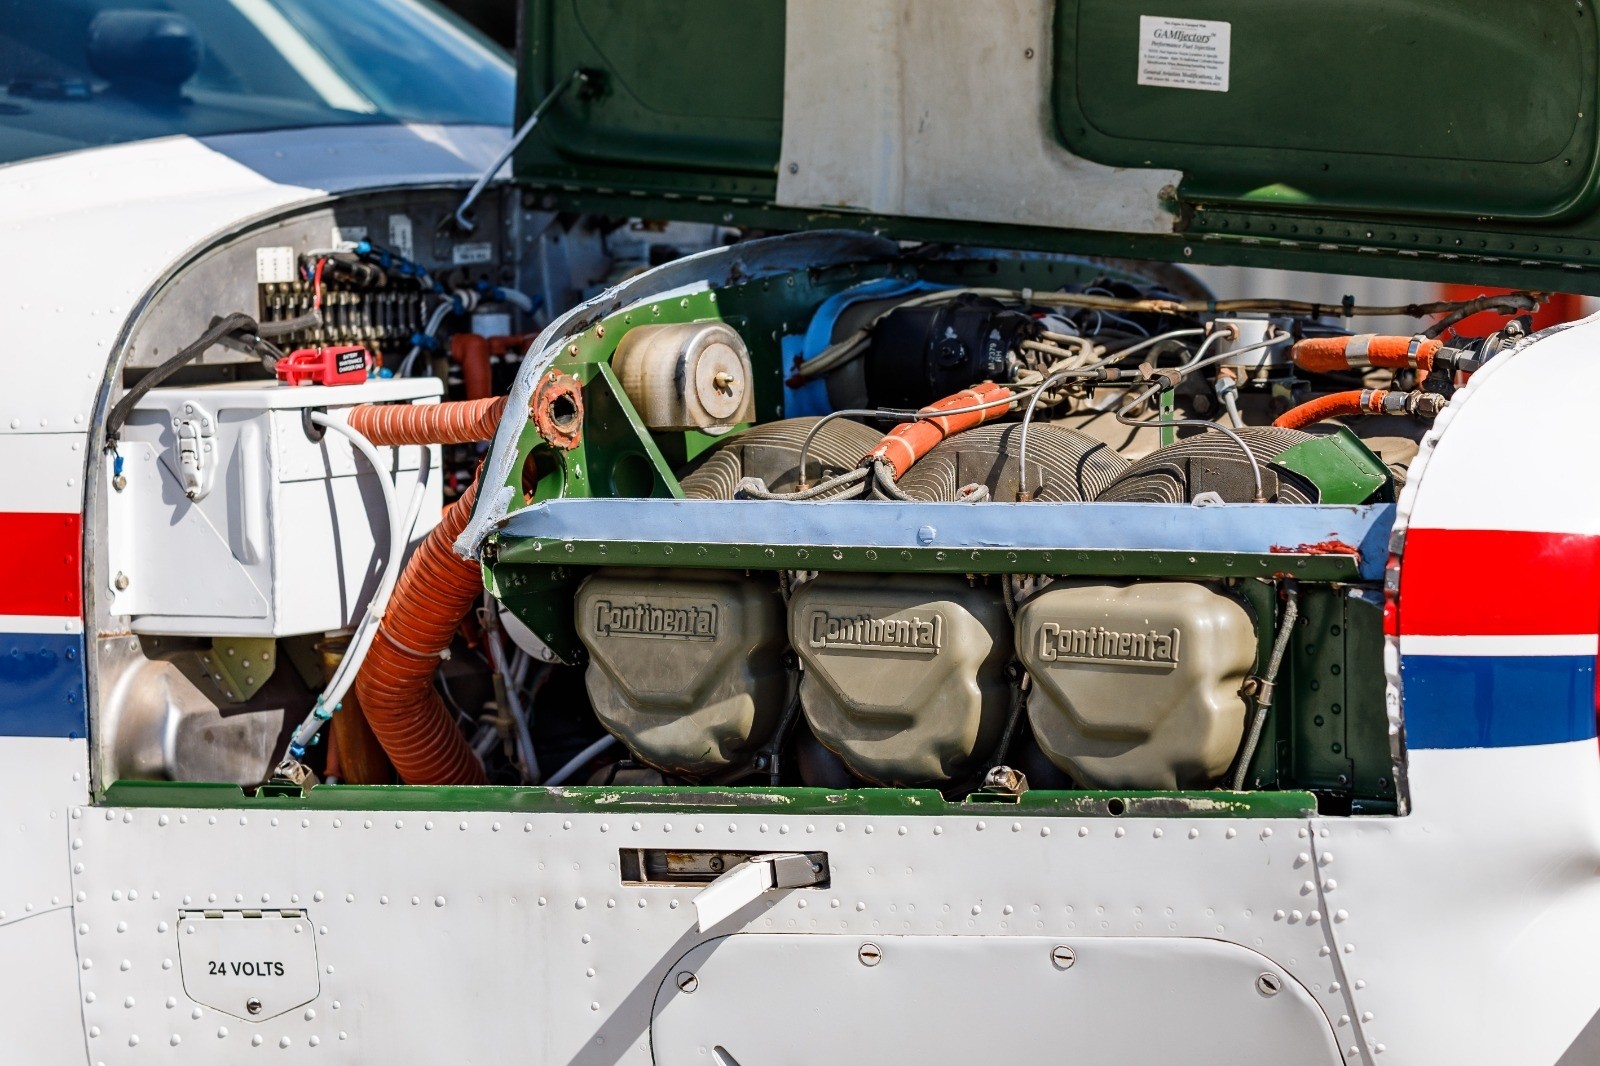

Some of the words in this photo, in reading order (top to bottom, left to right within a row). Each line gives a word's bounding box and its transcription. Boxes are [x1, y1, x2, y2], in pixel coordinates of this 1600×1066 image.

[1151, 41, 1181, 49] Performance
[594, 600, 718, 639] Continental
[810, 610, 942, 649] Continental
[1039, 622, 1181, 662] Continental
[208, 961, 227, 976] 24
[231, 961, 285, 976] VOLTS
